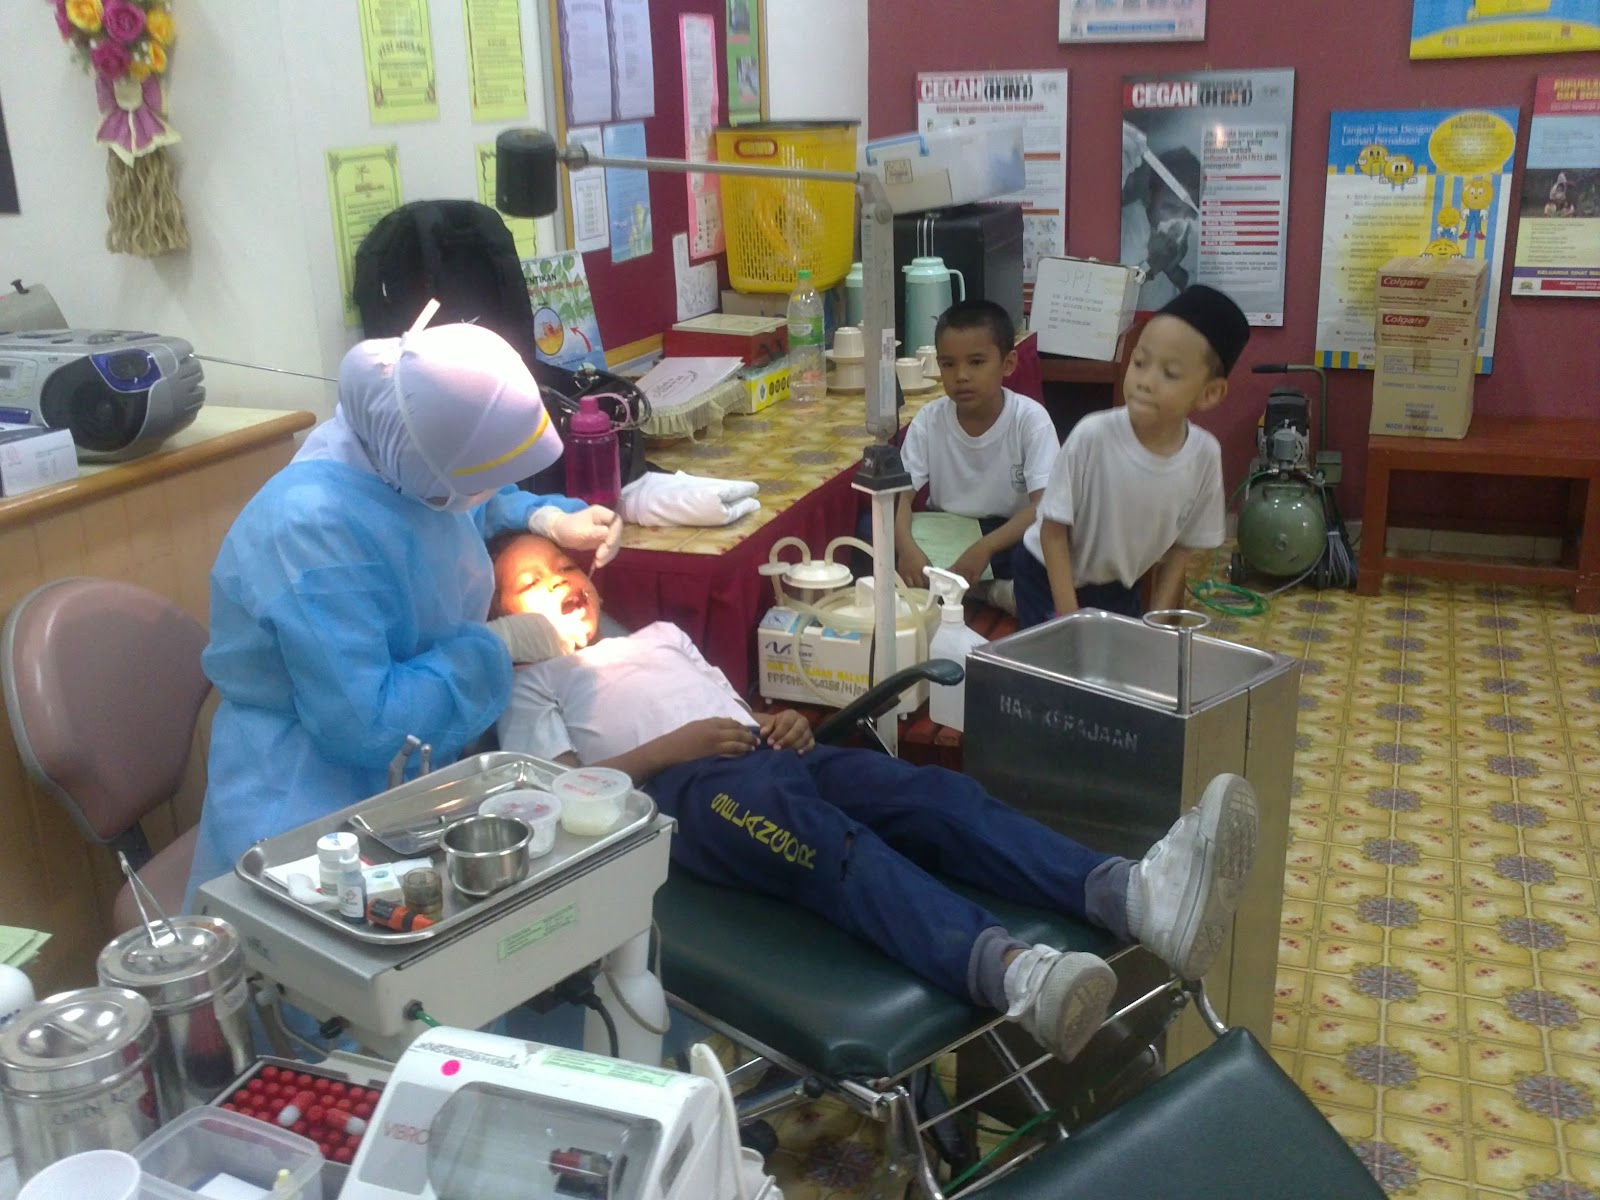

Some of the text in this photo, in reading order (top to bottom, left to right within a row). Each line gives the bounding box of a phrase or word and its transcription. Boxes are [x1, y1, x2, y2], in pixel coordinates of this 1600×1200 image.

[921, 77, 981, 102] CEGAH
[1132, 81, 1198, 108] CEGAH
[526, 272, 557, 284] ENTIKAN
[1383, 276, 1425, 289] Colgate
[1384, 314, 1427, 327] Colgate
[711, 792, 816, 870] SELANGOR
